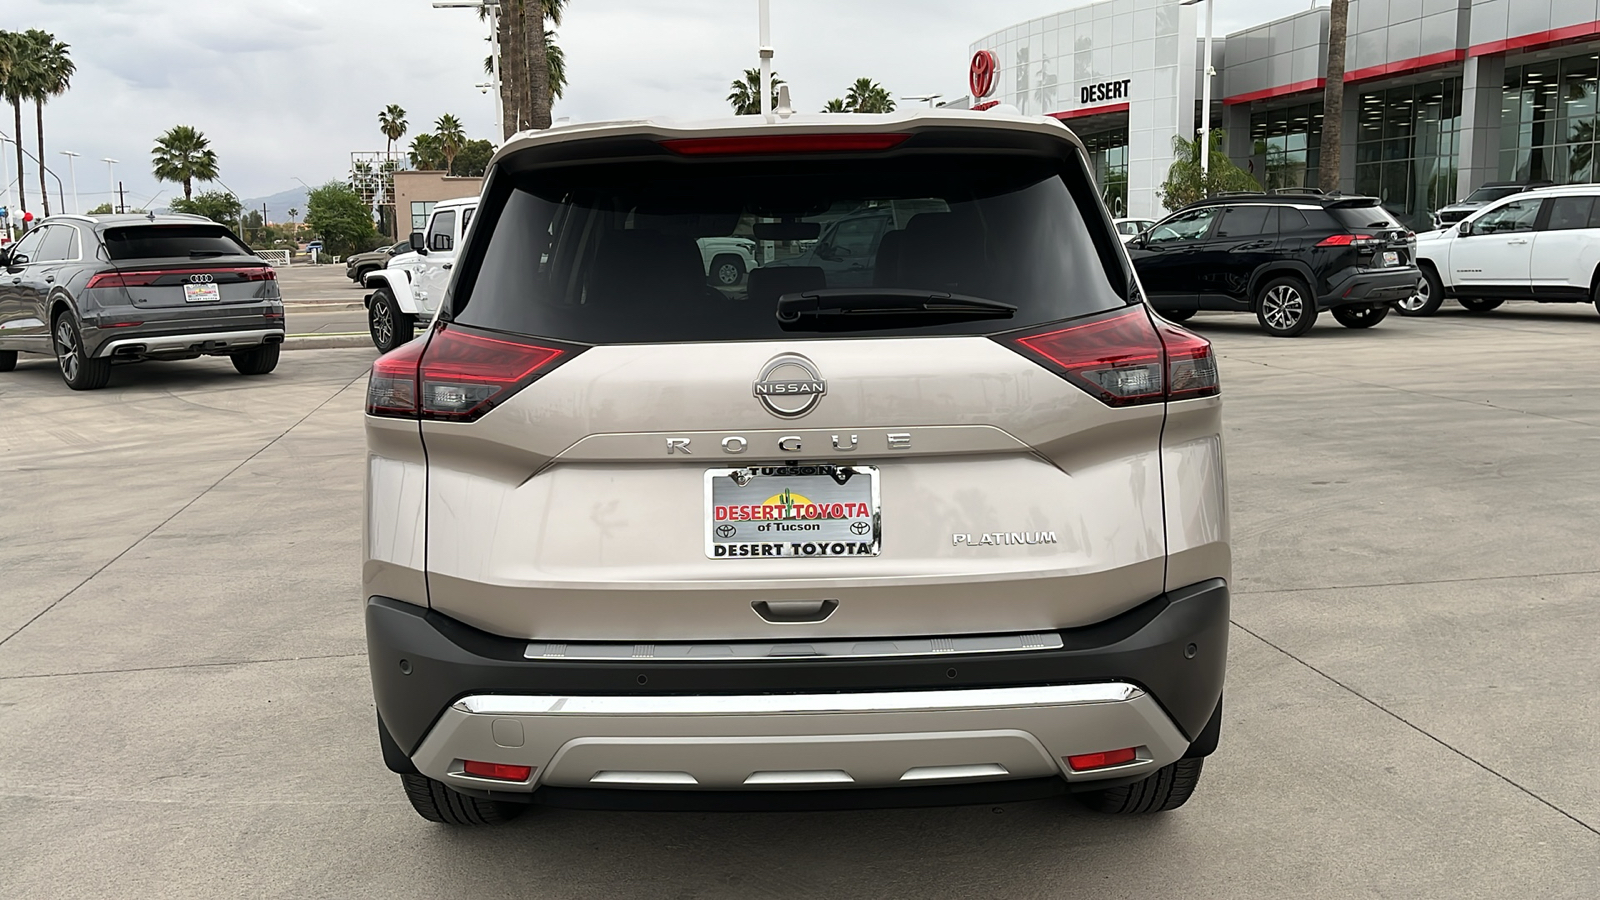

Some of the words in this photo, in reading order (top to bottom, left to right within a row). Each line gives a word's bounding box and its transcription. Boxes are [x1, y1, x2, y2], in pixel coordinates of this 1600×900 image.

[1081, 79, 1131, 104] DESERT
[756, 382, 824, 394] NISSAN
[666, 432, 912, 454] ROGUE
[749, 466, 831, 476] TUCSON
[715, 504, 786, 521] DESERT
[793, 502, 869, 520] TOYOTA
[757, 522, 771, 532] of
[774, 522, 820, 532] Tucson
[952, 531, 1057, 546] PLATINUM
[714, 543, 784, 557] DESERT
[791, 542, 871, 556] TOYOTA
